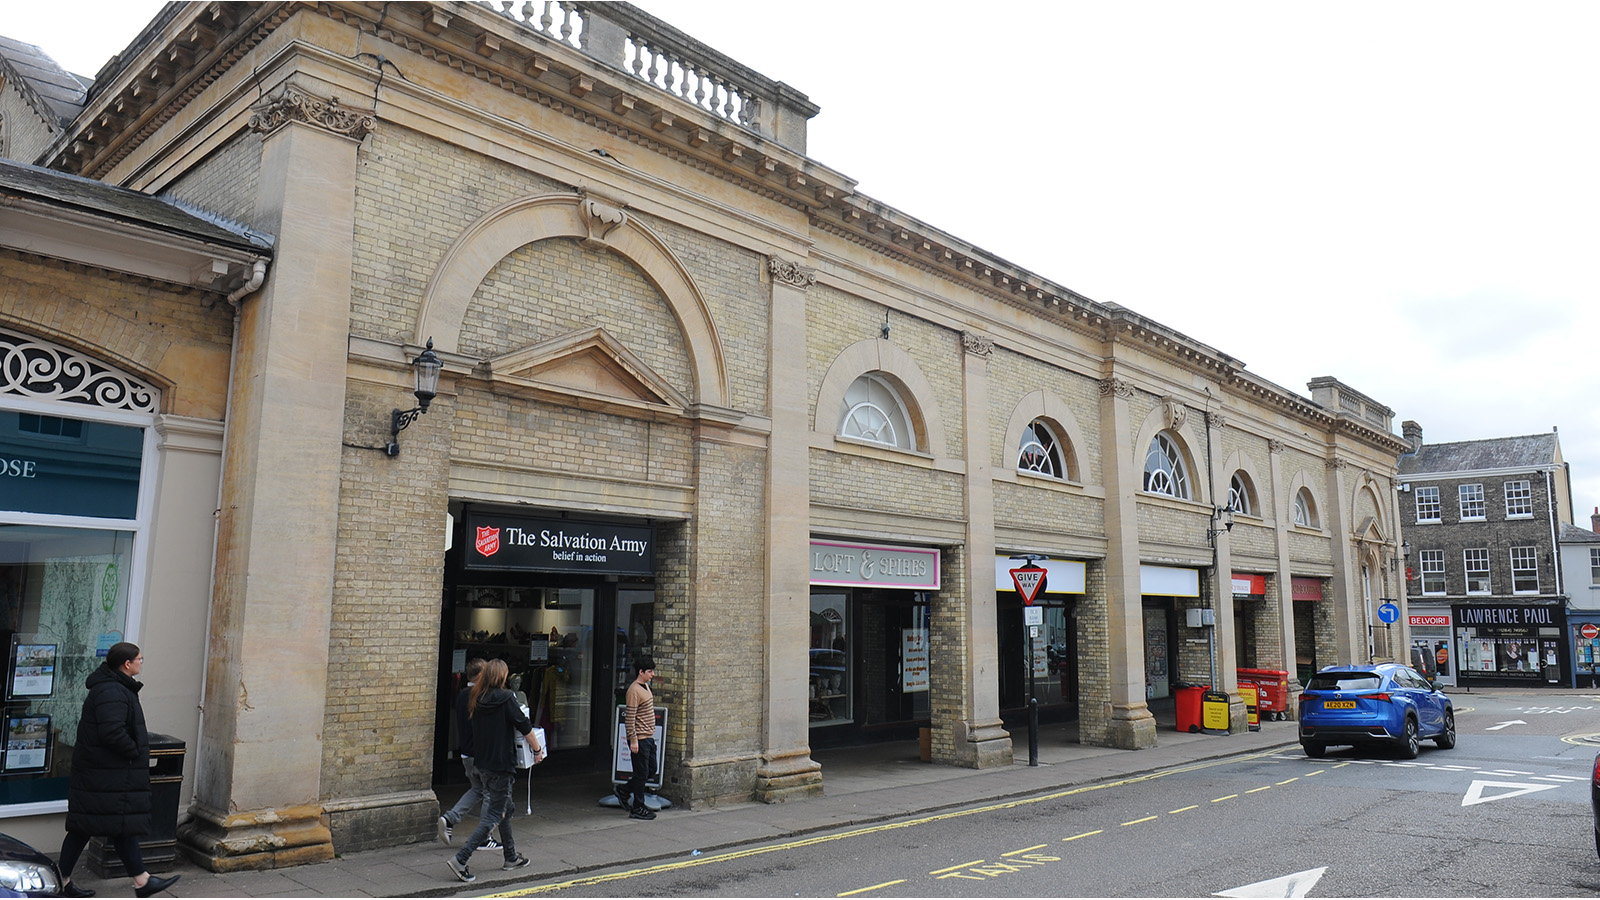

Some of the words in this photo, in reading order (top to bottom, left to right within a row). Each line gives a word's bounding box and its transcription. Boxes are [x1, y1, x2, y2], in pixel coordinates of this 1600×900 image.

[477, 533, 498, 548] SALVATION
[481, 530, 490, 538] THE
[506, 527, 536, 546] The
[540, 530, 608, 551] Salvation
[610, 535, 648, 556] Army
[484, 542, 497, 552] ARMY
[553, 551, 575, 561] belief
[576, 552, 583, 561] in
[584, 554, 607, 563] action
[813, 552, 855, 573] LOFT
[859, 550, 875, 580] &
[879, 557, 927, 577] SPIRES
[1017, 573, 1038, 581] GIVE
[1460, 608, 1519, 624] LAWRENCE
[1524, 608, 1552, 624] PAUL
[936, 853, 1061, 880] TAXIS
